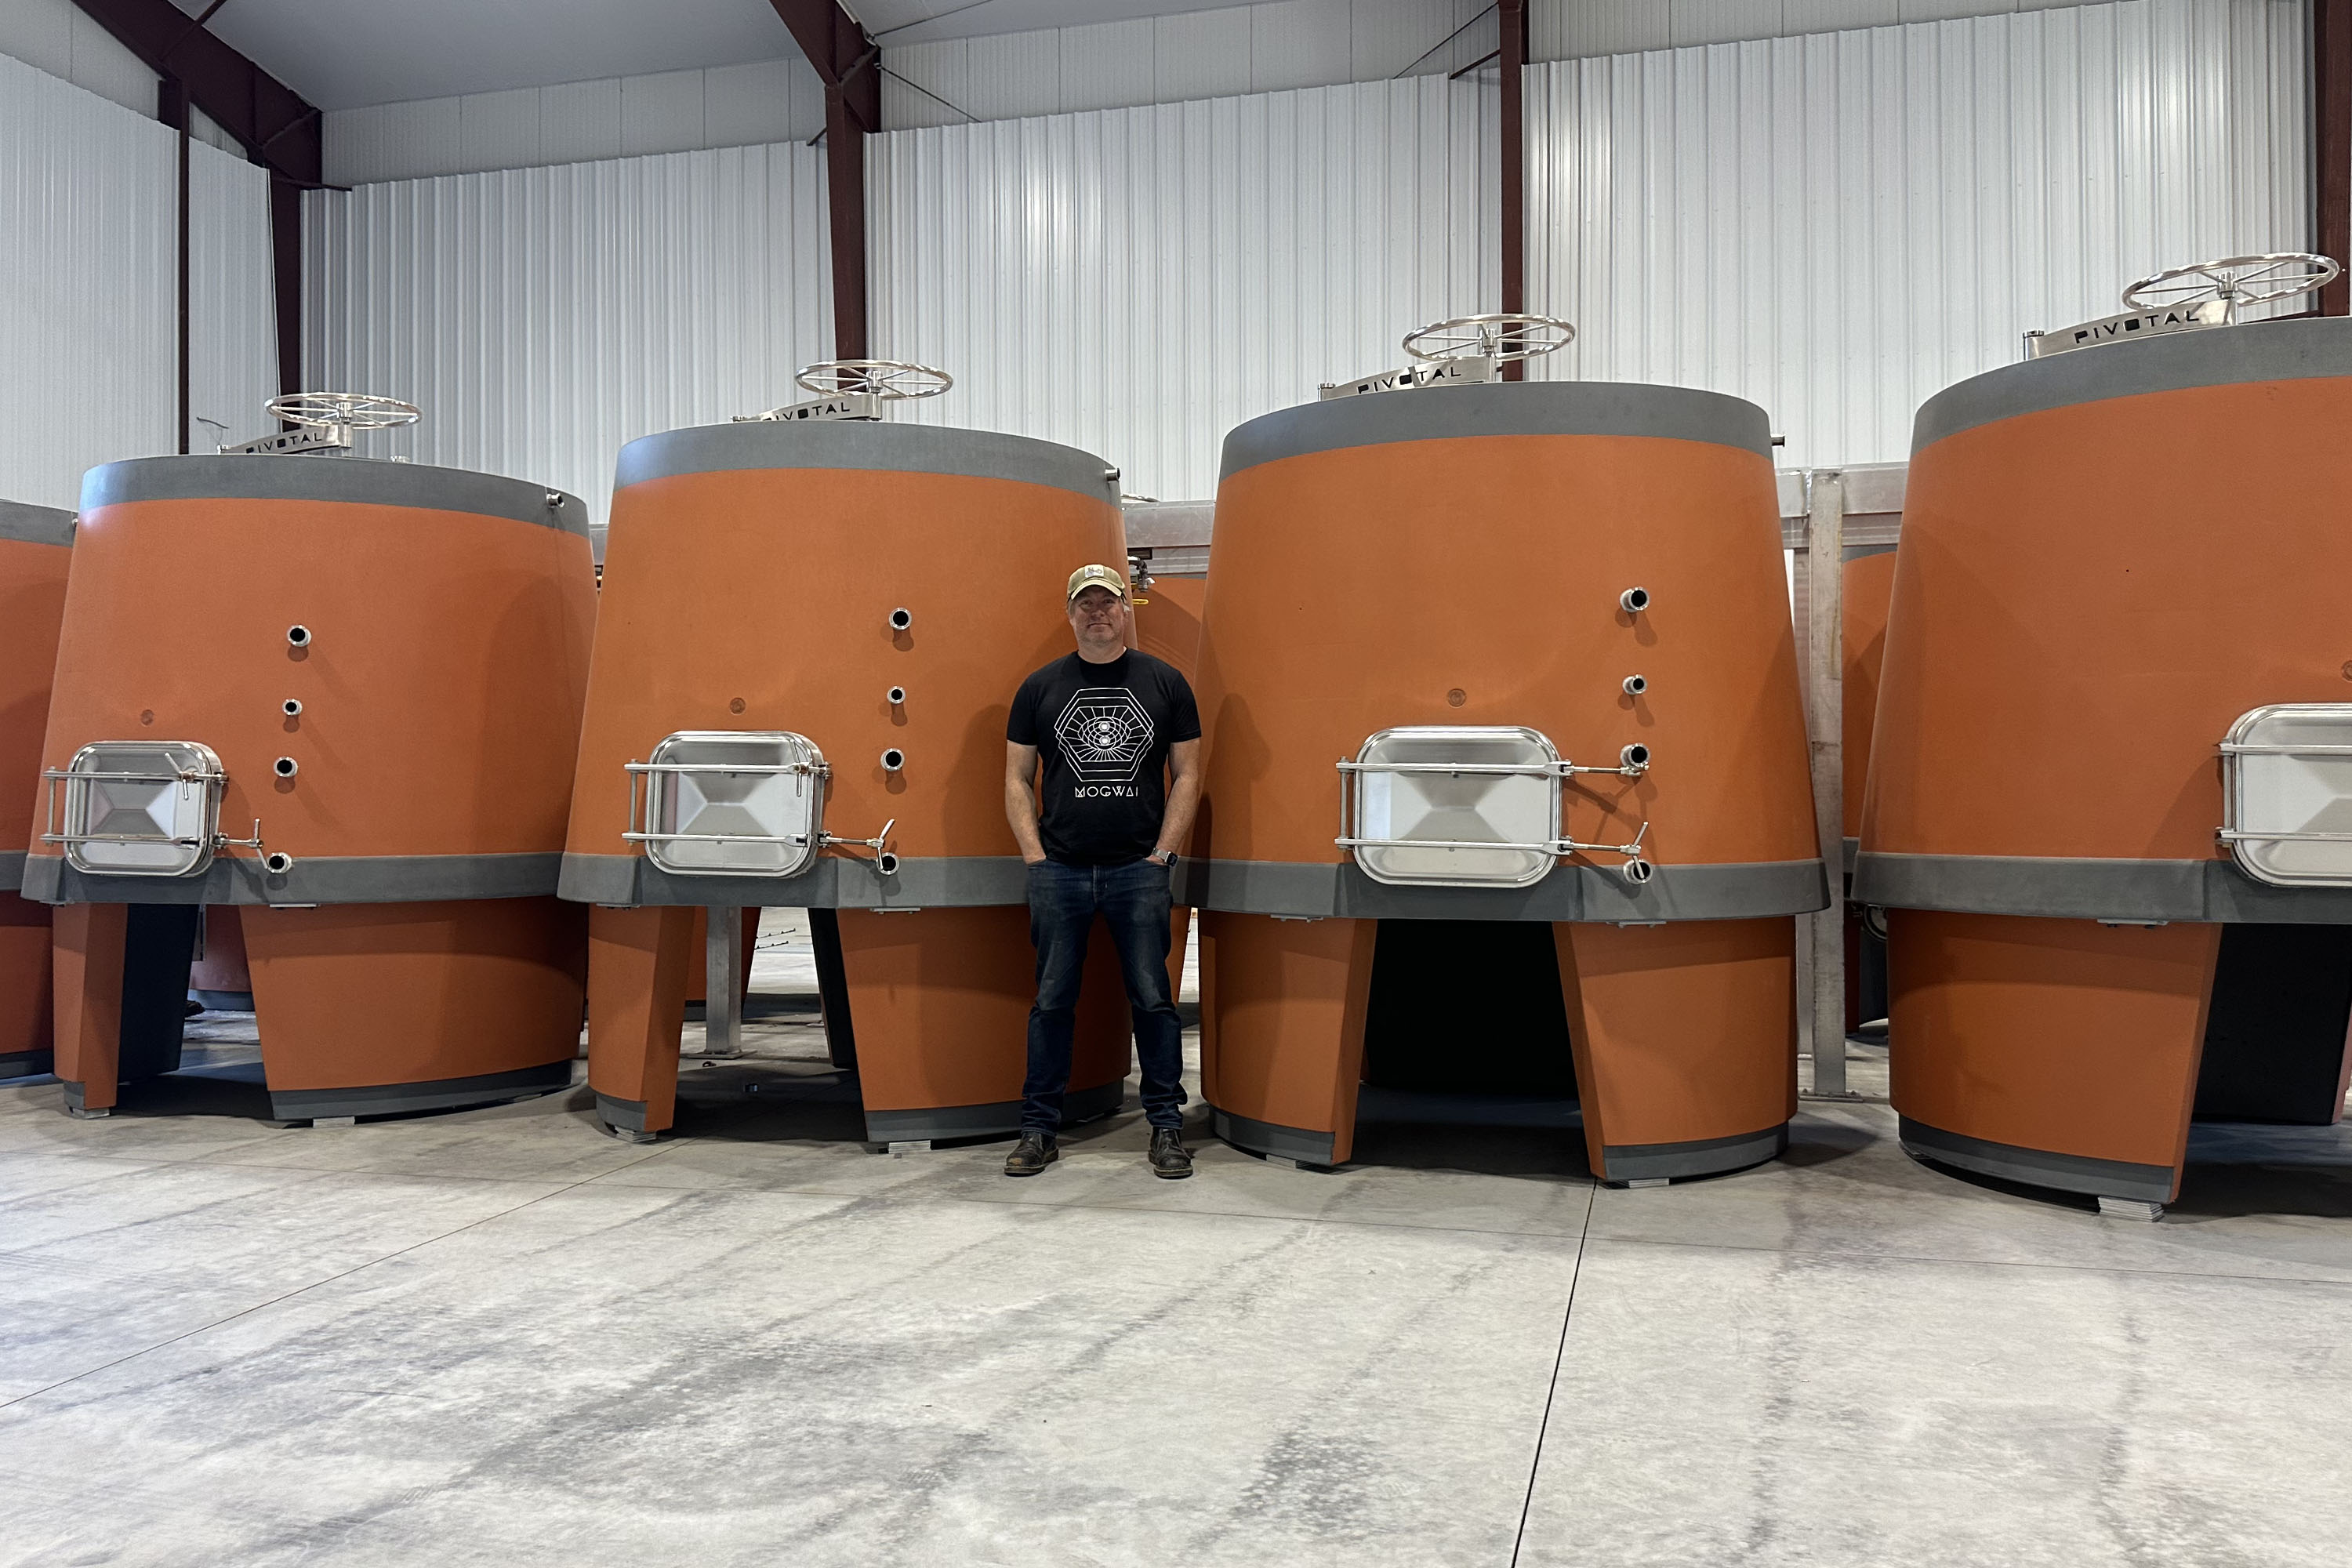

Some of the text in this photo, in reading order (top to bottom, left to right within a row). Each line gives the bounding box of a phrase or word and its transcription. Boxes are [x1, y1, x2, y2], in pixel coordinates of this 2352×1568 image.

[2074, 310, 2199, 343] PIVOTAL
[1357, 366, 1461, 394] PIVOTAL
[762, 401, 851, 421] IVOTAL
[1075, 786, 1138, 798] MOGWAI
